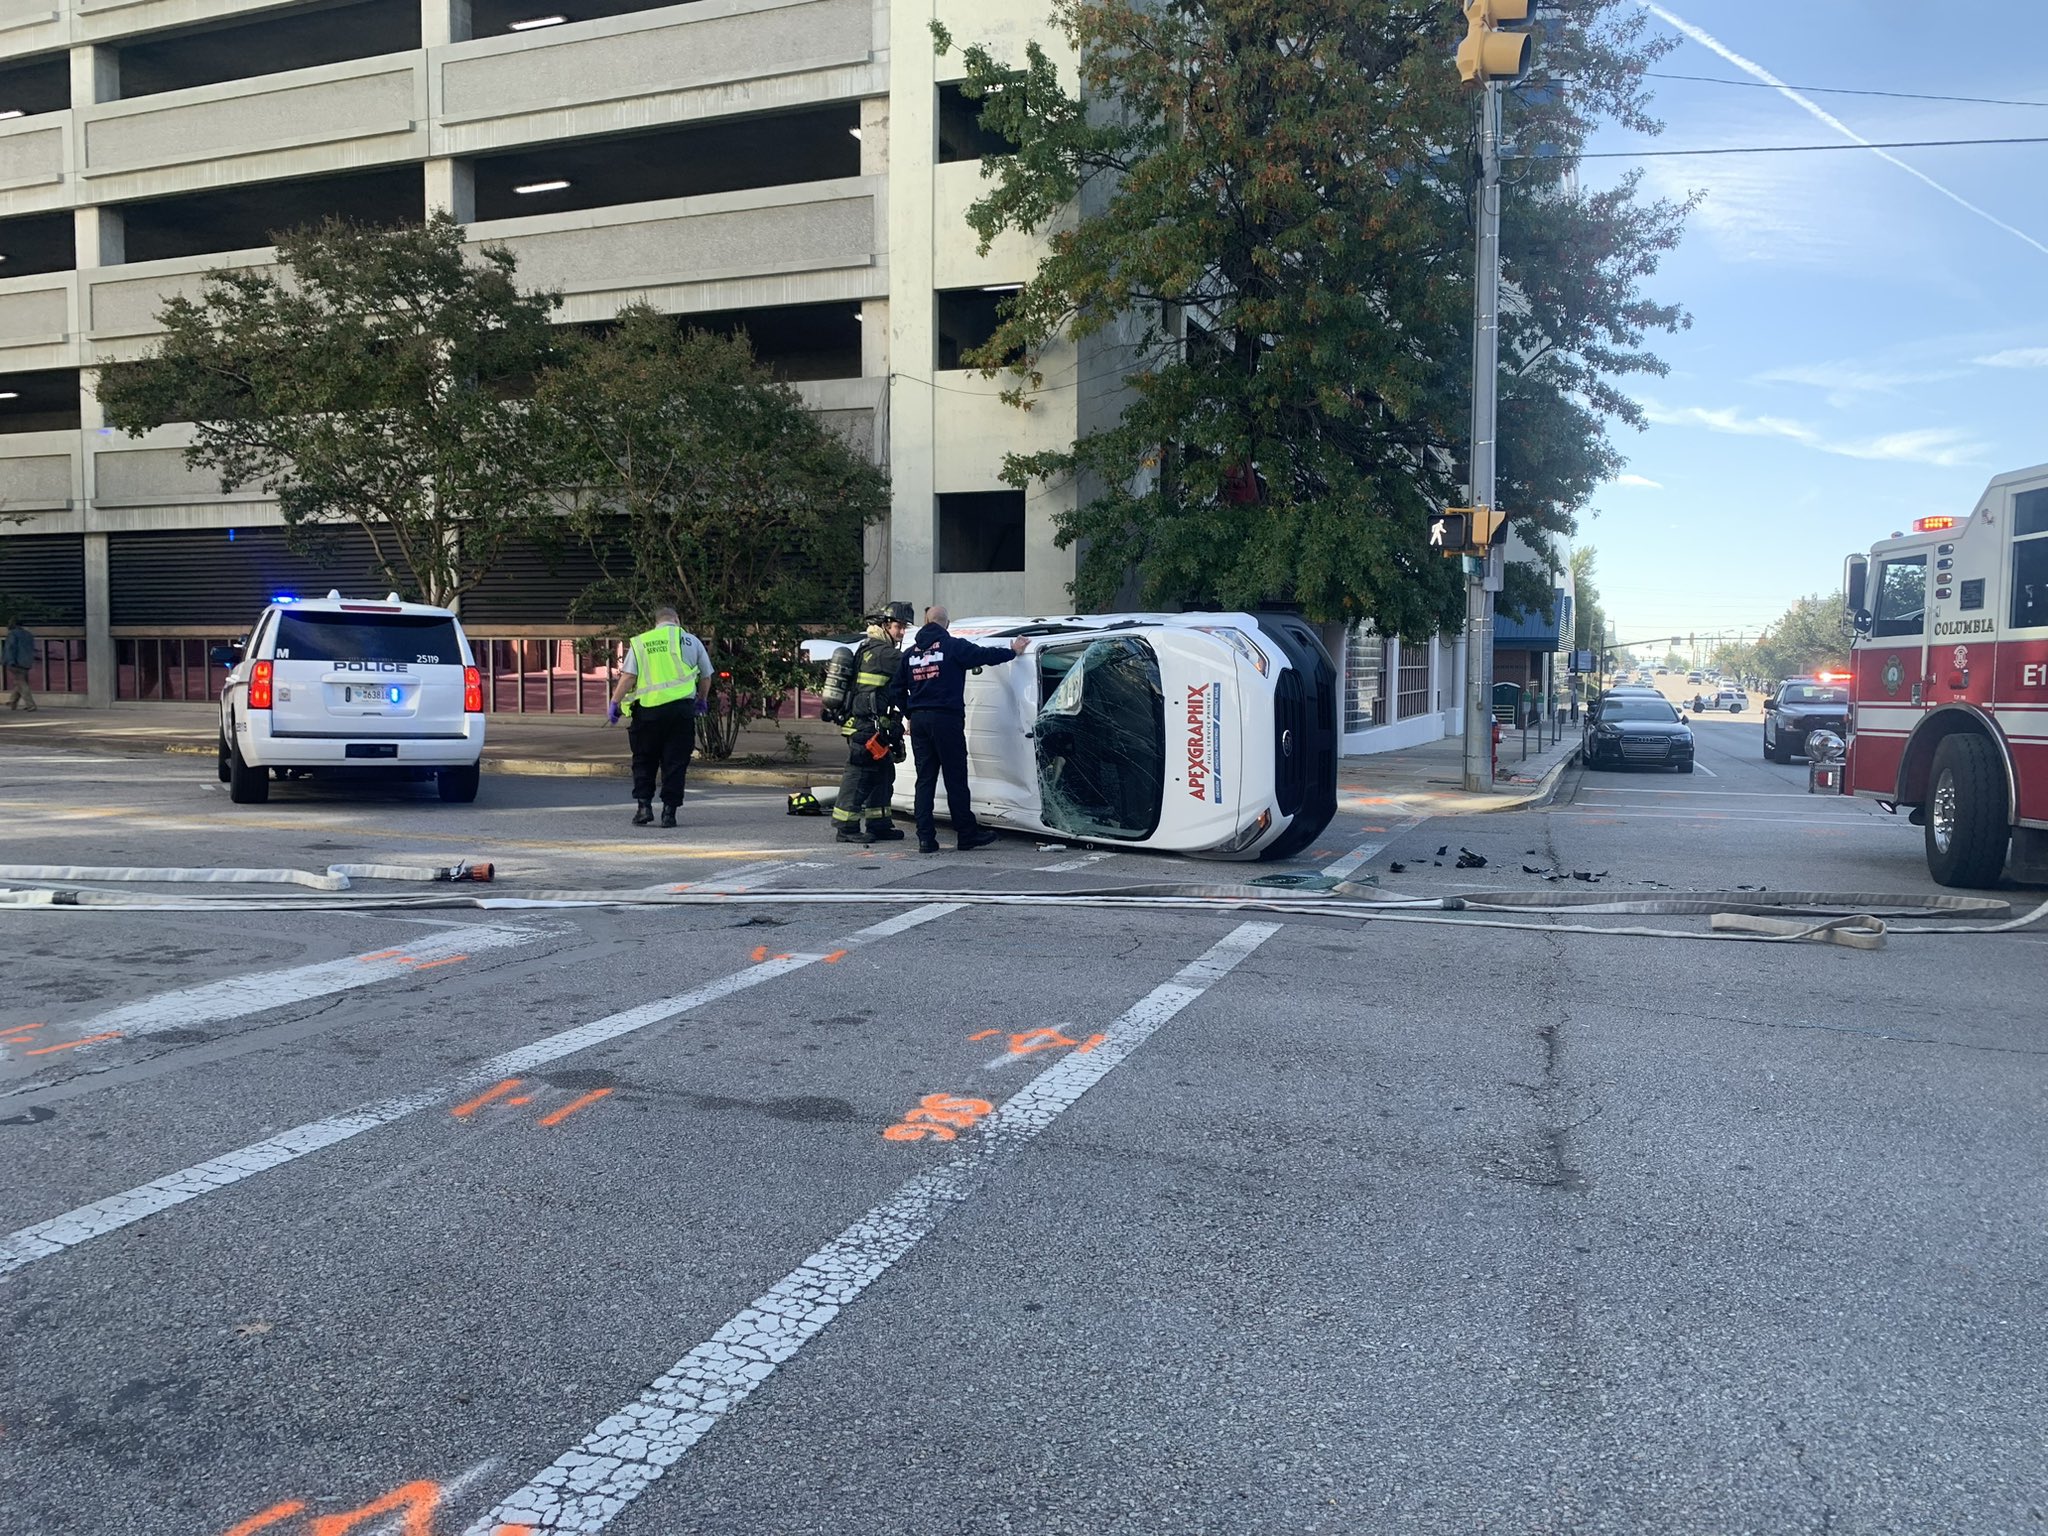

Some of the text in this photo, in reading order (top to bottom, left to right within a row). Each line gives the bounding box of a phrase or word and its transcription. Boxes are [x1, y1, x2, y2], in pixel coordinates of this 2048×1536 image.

[1934, 618, 1994, 636] COLUMBIA
[276, 648, 290, 659] M
[416, 654, 440, 664] 25119
[333, 661, 409, 674] POLICE
[1187, 683, 1210, 801] APEXGRAPHIX
